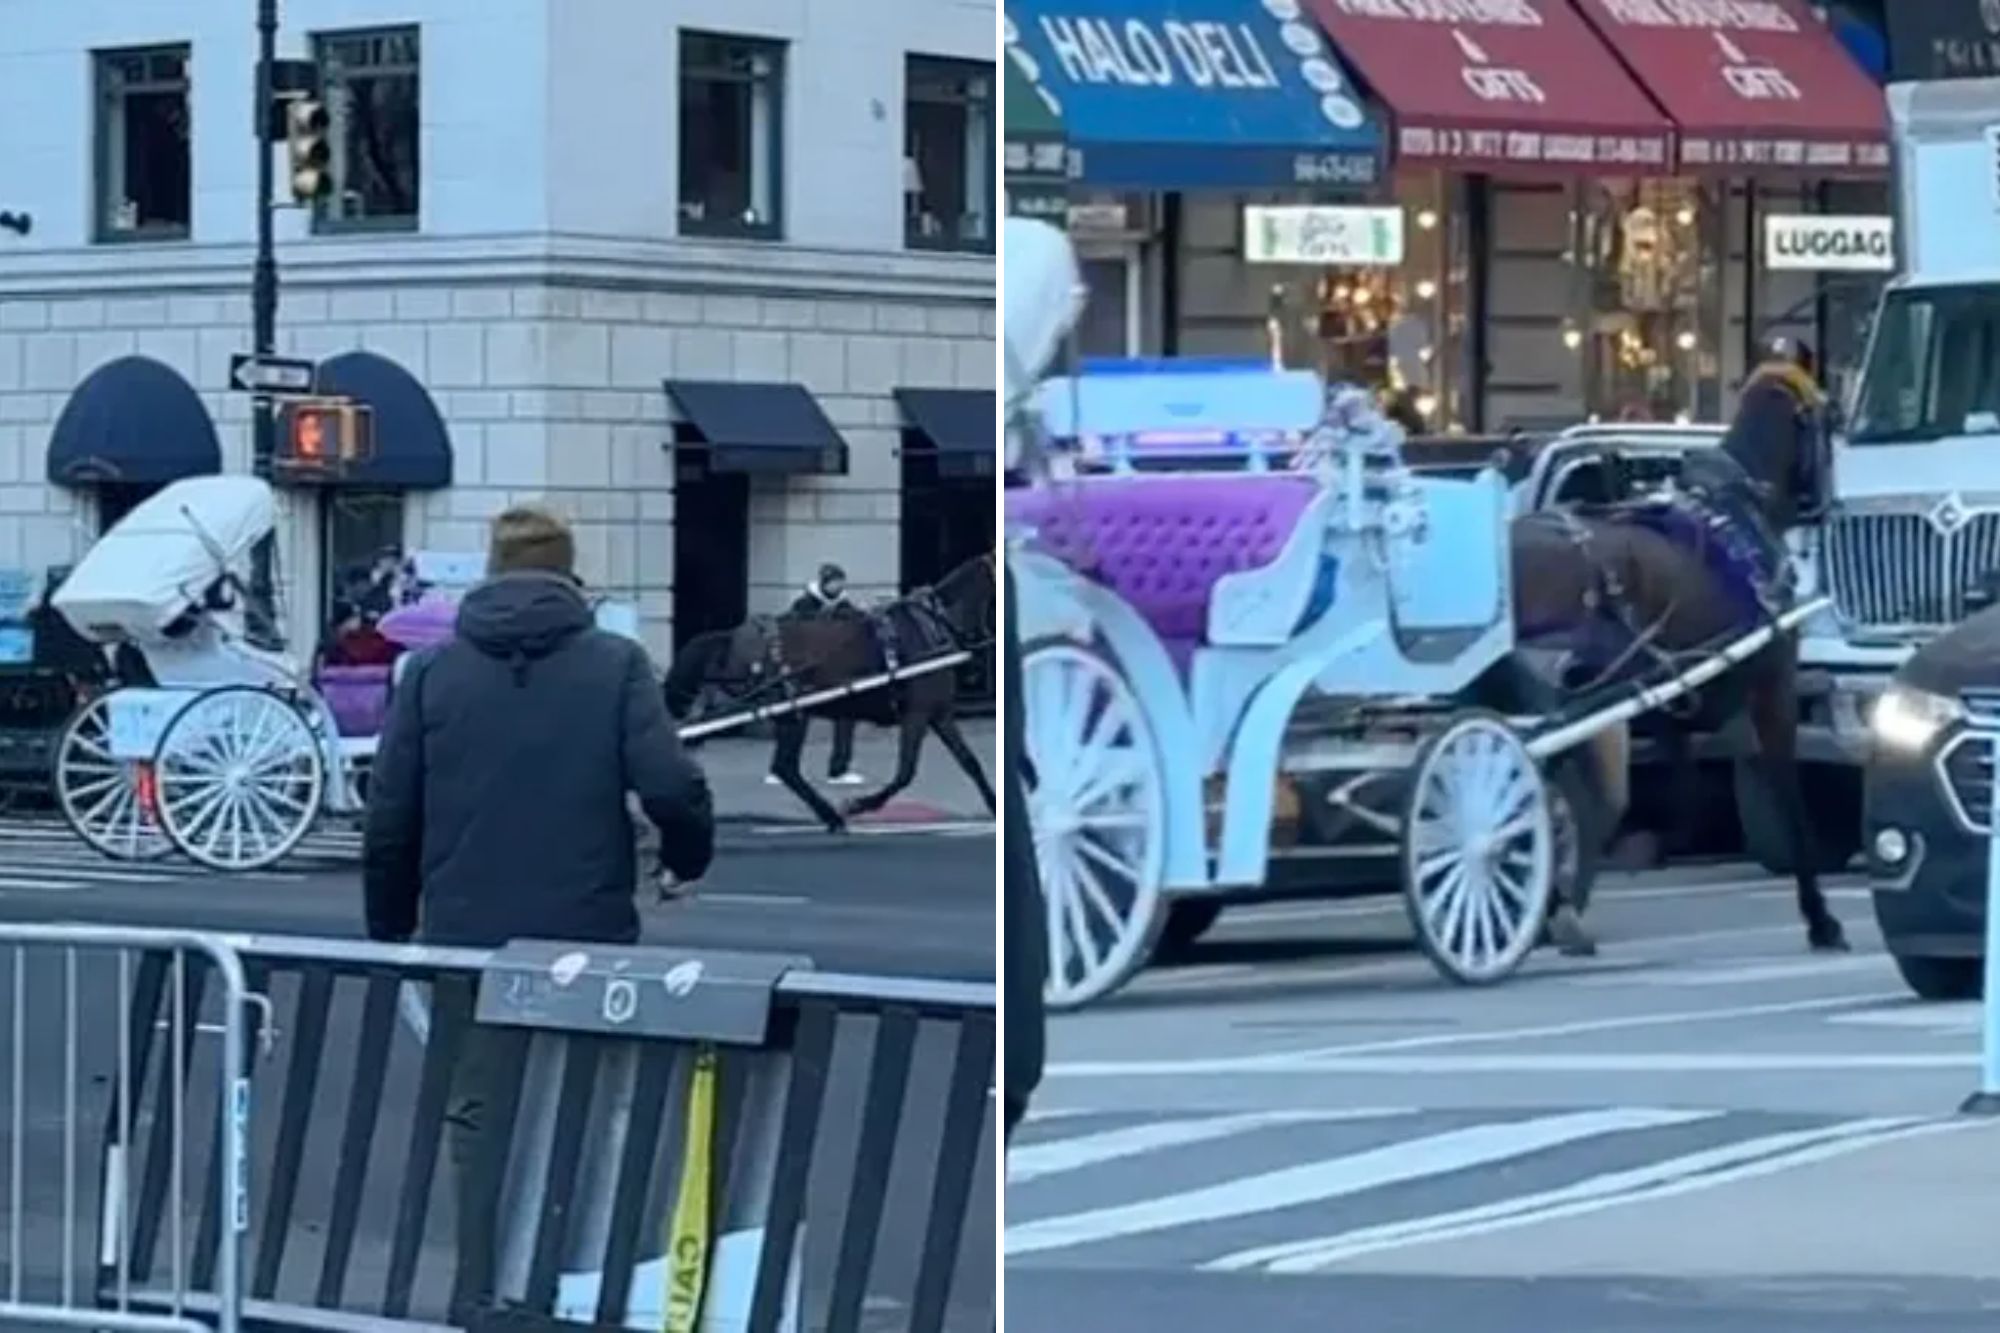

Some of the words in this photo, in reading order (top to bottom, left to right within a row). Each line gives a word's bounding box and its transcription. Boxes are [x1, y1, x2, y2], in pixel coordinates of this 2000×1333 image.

[1038, 15, 1172, 86] HALO
[1163, 20, 1280, 87] DELI
[1775, 229, 1887, 257] LUGGAG
